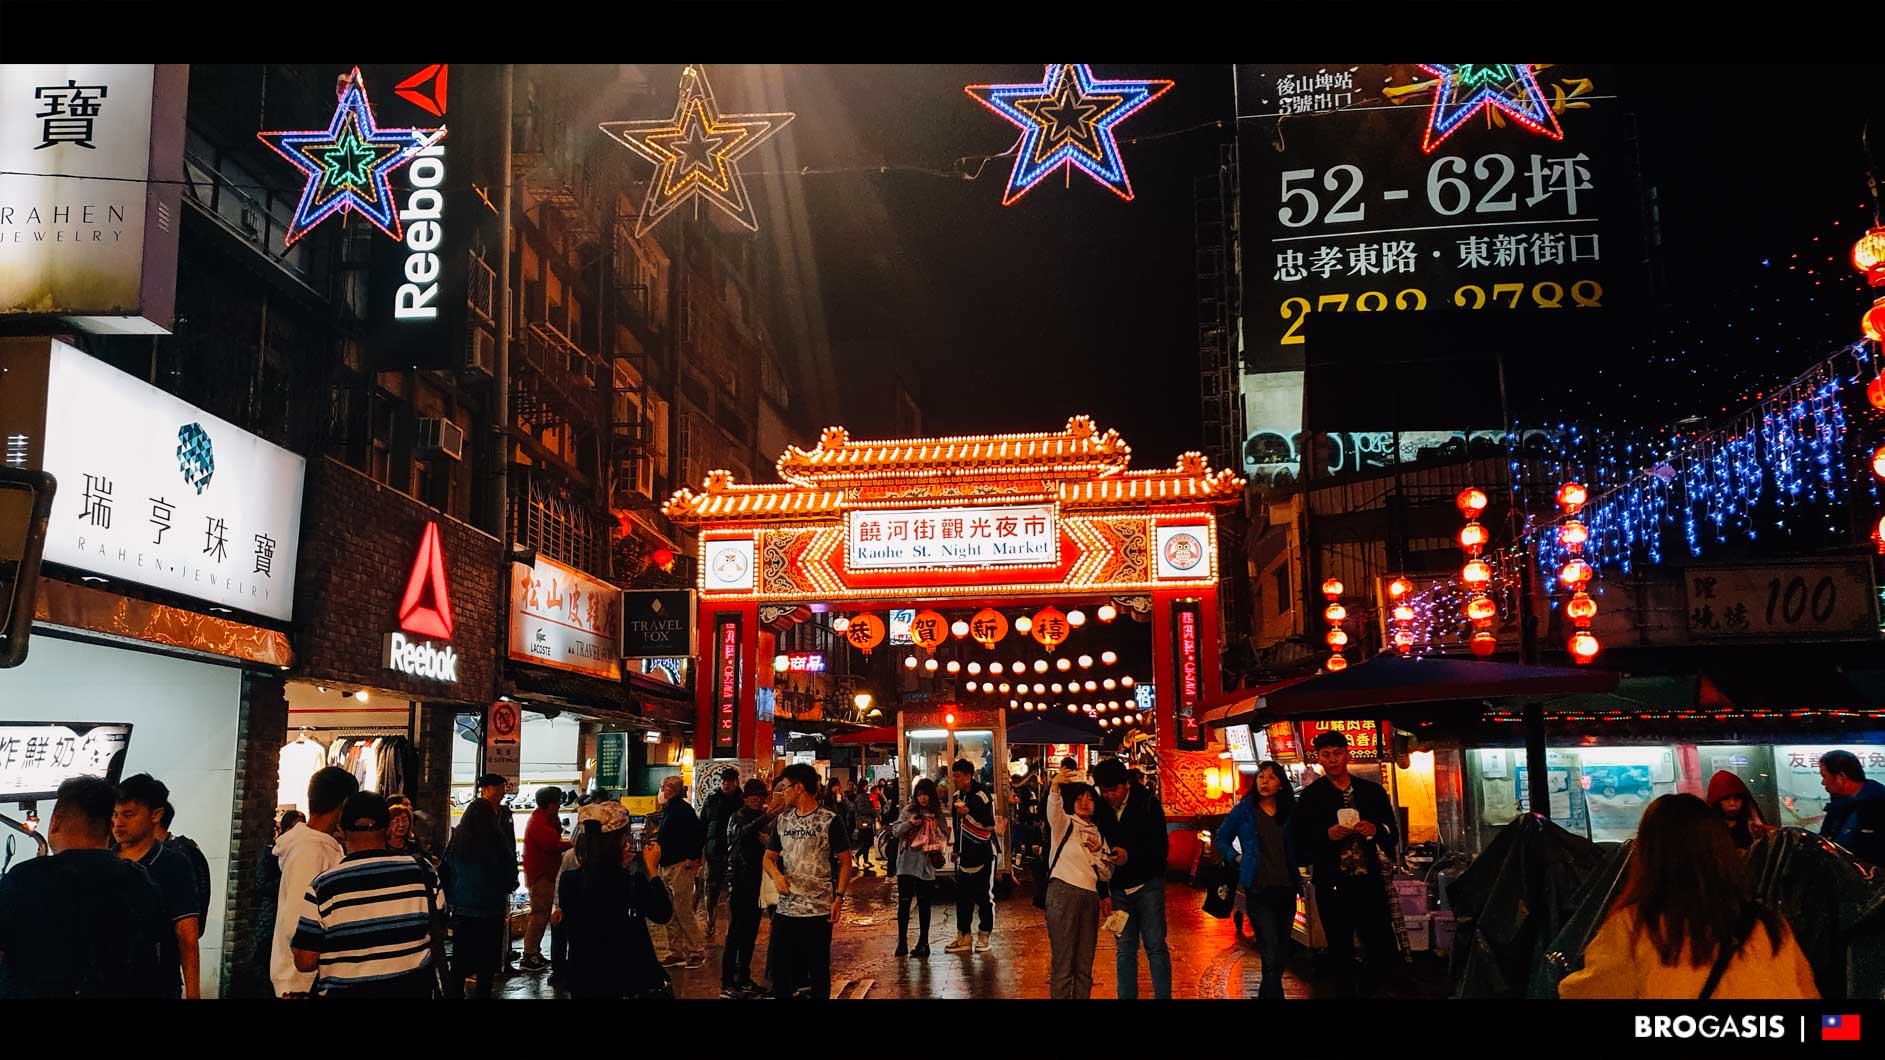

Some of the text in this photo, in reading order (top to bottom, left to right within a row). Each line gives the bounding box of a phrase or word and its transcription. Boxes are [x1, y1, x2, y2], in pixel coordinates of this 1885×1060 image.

[1276, 71, 1353, 97] 後山埤站
[33, 80, 107, 149] 寶
[1277, 92, 1353, 116] 3號出口
[0, 205, 124, 225] RAHEN
[394, 124, 447, 320] Reebok
[0, 230, 123, 243] JEWELRY
[78, 473, 277, 578] 瑞亨珠寶
[859, 515, 1047, 542] 饒河街觀光夜市
[858, 541, 1049, 559] Raohe St. Night Market
[78, 537, 270, 600] RAHEN JEWELRY
[1765, 576, 1837, 624] 100
[631, 619, 683, 633] TRAVEL
[643, 630, 671, 642] FOX
[849, 621, 873, 644] 恭
[915, 619, 937, 643] 賀
[973, 618, 998, 640] 新
[1039, 617, 1065, 641] 禧
[389, 631, 457, 684] Reebok
[530, 642, 551, 656] LACOSTE
[783, 829, 817, 837] DAYTONA
